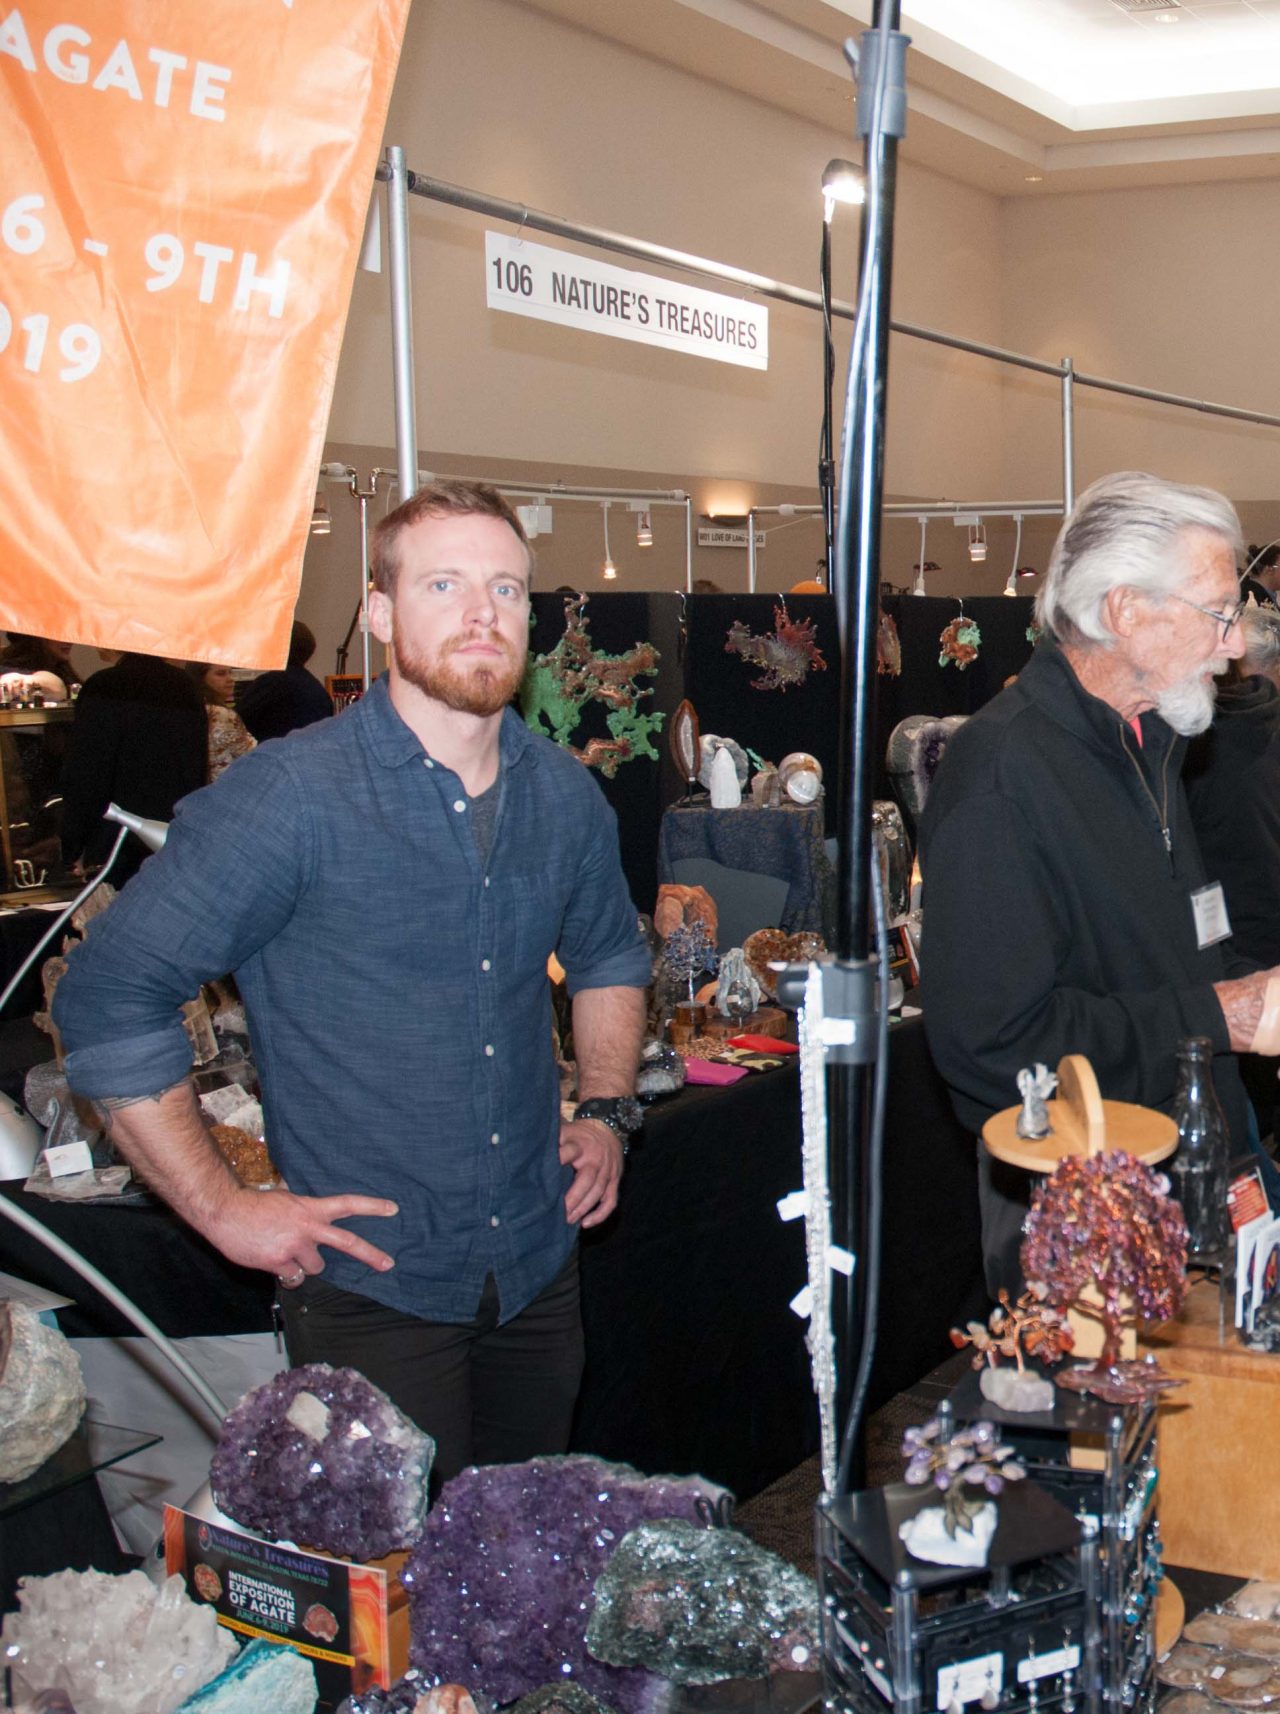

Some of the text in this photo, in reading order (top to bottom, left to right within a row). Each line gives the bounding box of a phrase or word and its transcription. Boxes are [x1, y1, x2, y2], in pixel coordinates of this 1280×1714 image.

[0, 8, 232, 122] AGATE
[2, 194, 45, 254] 6
[144, 233, 291, 319] 9TH
[493, 256, 757, 350] 106 NATURE'S TREASURES
[712, 533, 724, 542] LOVE
[264, 1546, 329, 1579] Treasures
[229, 1570, 295, 1600] INTERNATIONAL
[229, 1580, 295, 1611] EXPOSITION
[229, 1591, 296, 1625] OF AGATE
